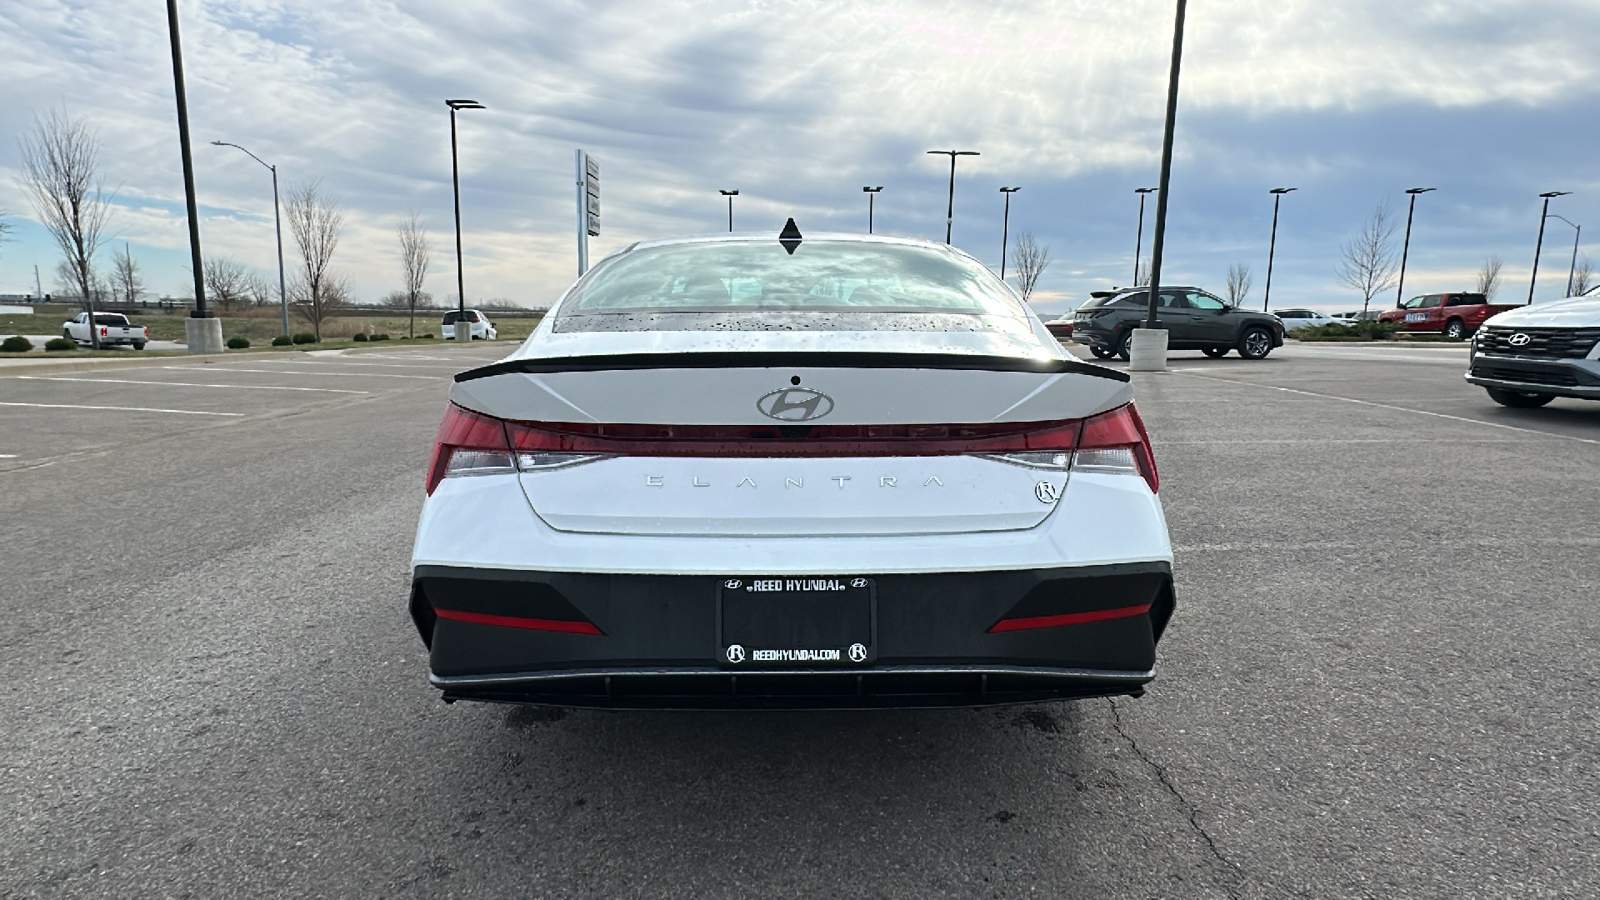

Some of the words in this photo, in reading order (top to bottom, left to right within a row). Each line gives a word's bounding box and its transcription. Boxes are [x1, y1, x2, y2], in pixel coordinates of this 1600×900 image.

[646, 475, 943, 490] ELANTRA
[753, 580, 783, 592] REED
[786, 579, 839, 591] HYUNDAI
[752, 649, 840, 661] REEDHYUNDAI.COM
